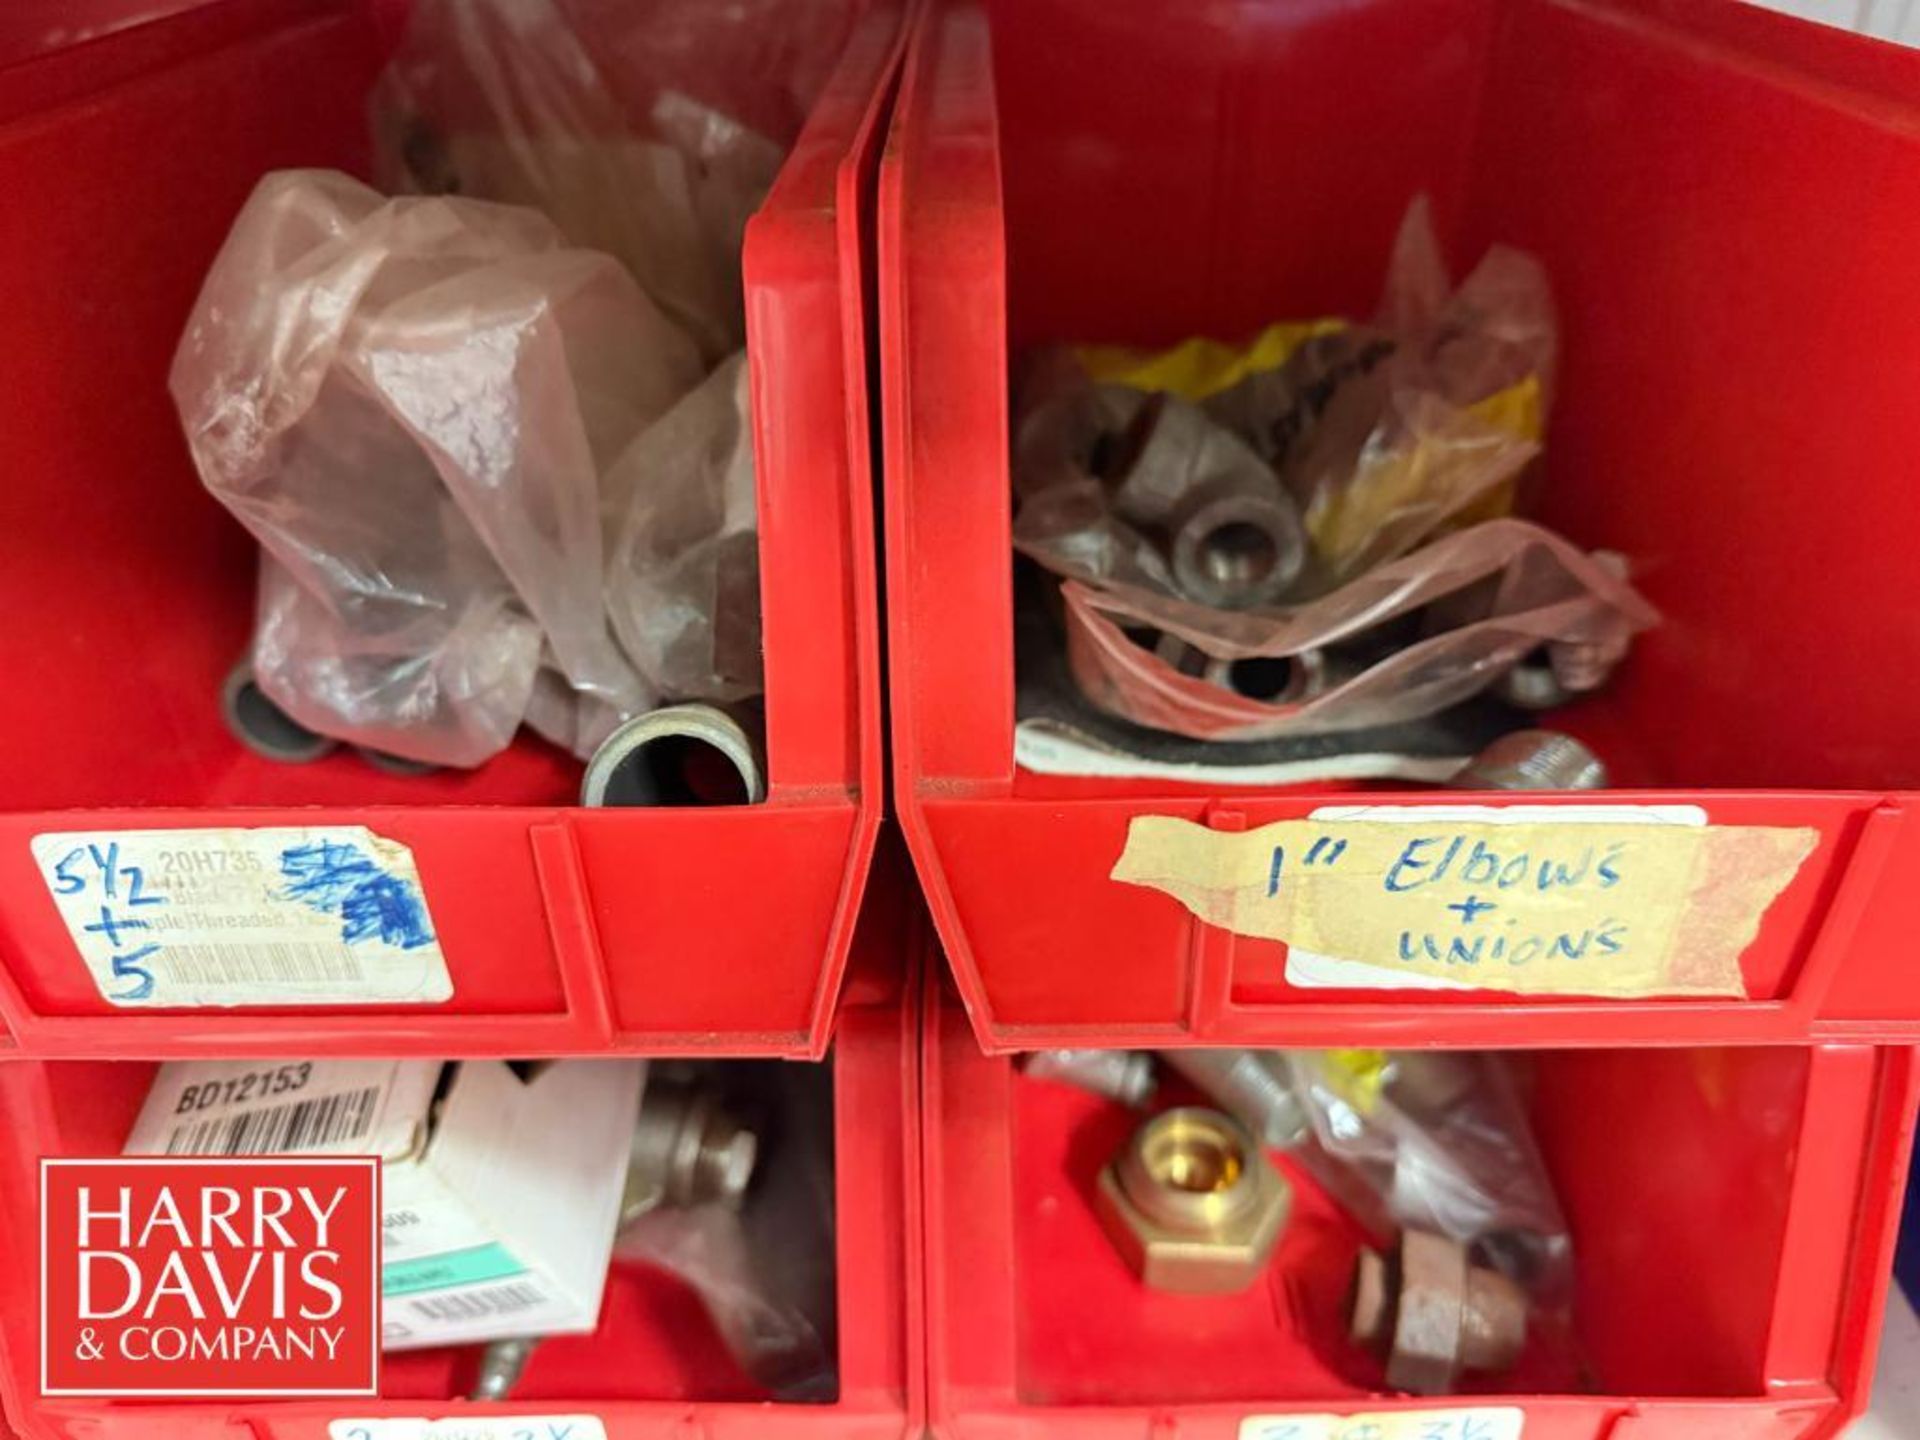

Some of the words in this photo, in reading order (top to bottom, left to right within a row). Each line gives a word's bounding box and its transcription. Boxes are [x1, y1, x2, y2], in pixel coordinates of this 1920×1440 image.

[158, 849, 263, 874] 20H735
[1446, 893, 1499, 925] +
[108, 943, 162, 1000] 5
[174, 1062, 313, 1116] BD12153
